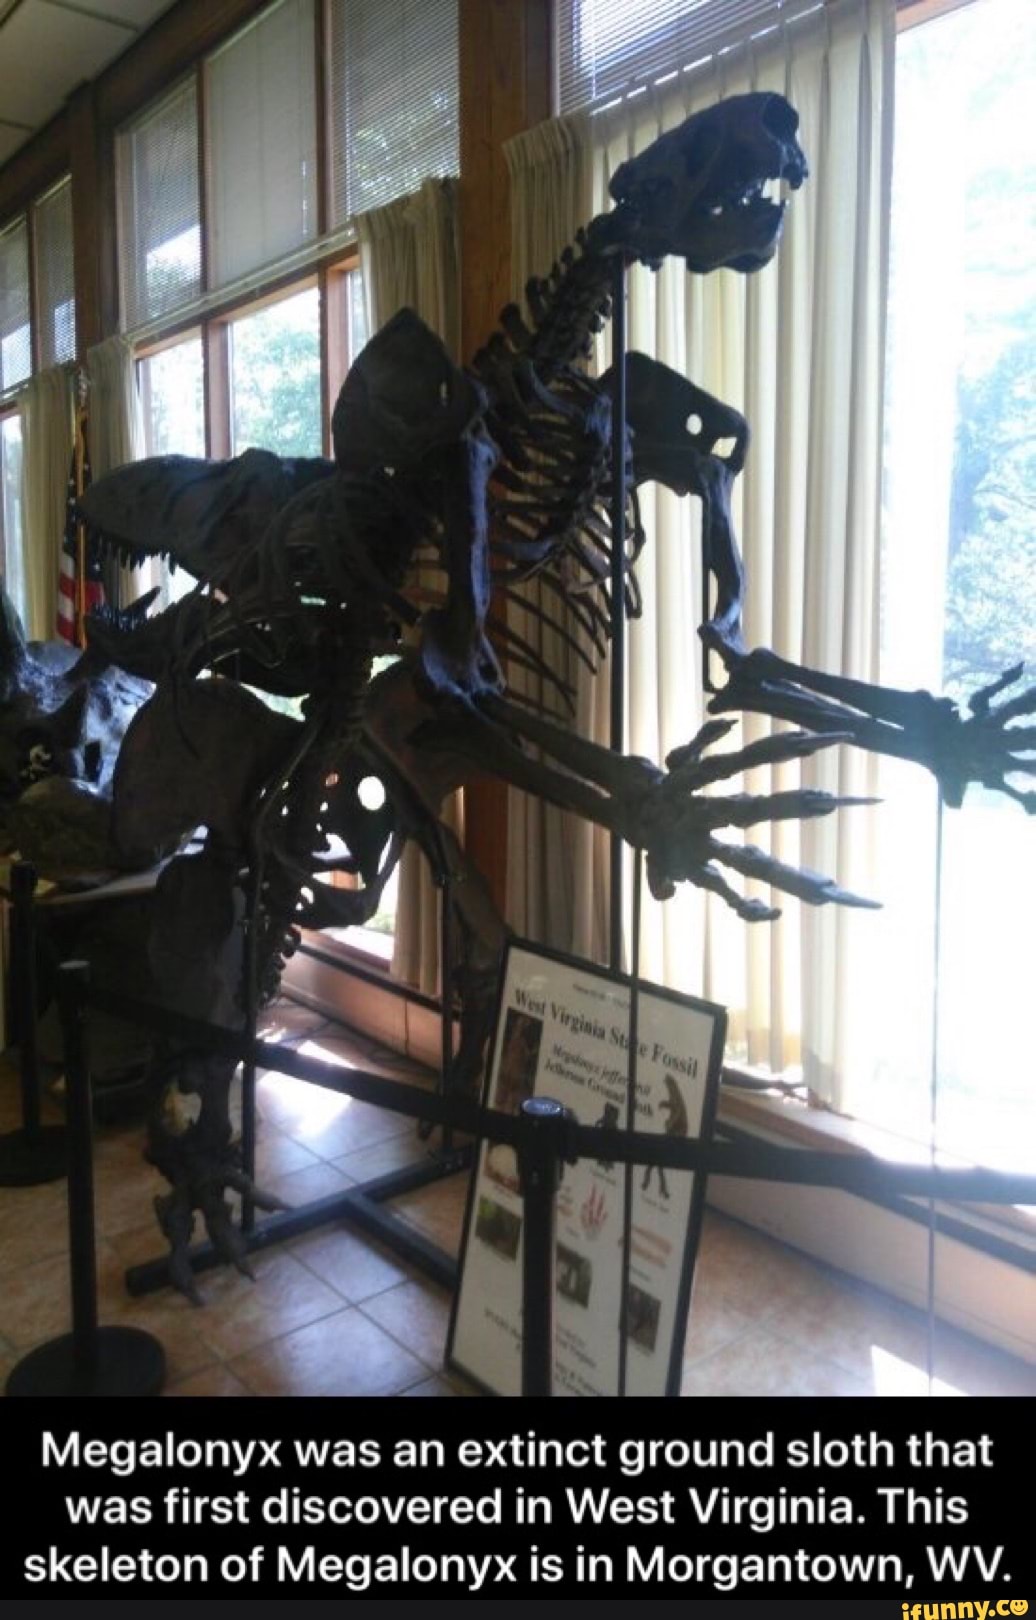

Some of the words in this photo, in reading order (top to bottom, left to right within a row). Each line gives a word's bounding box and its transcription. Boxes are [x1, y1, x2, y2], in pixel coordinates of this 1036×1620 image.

[514, 988, 546, 1017] West
[551, 1001, 606, 1040] Virginia
[608, 1025, 651, 1058] Stte
[652, 1041, 699, 1080] Fossil
